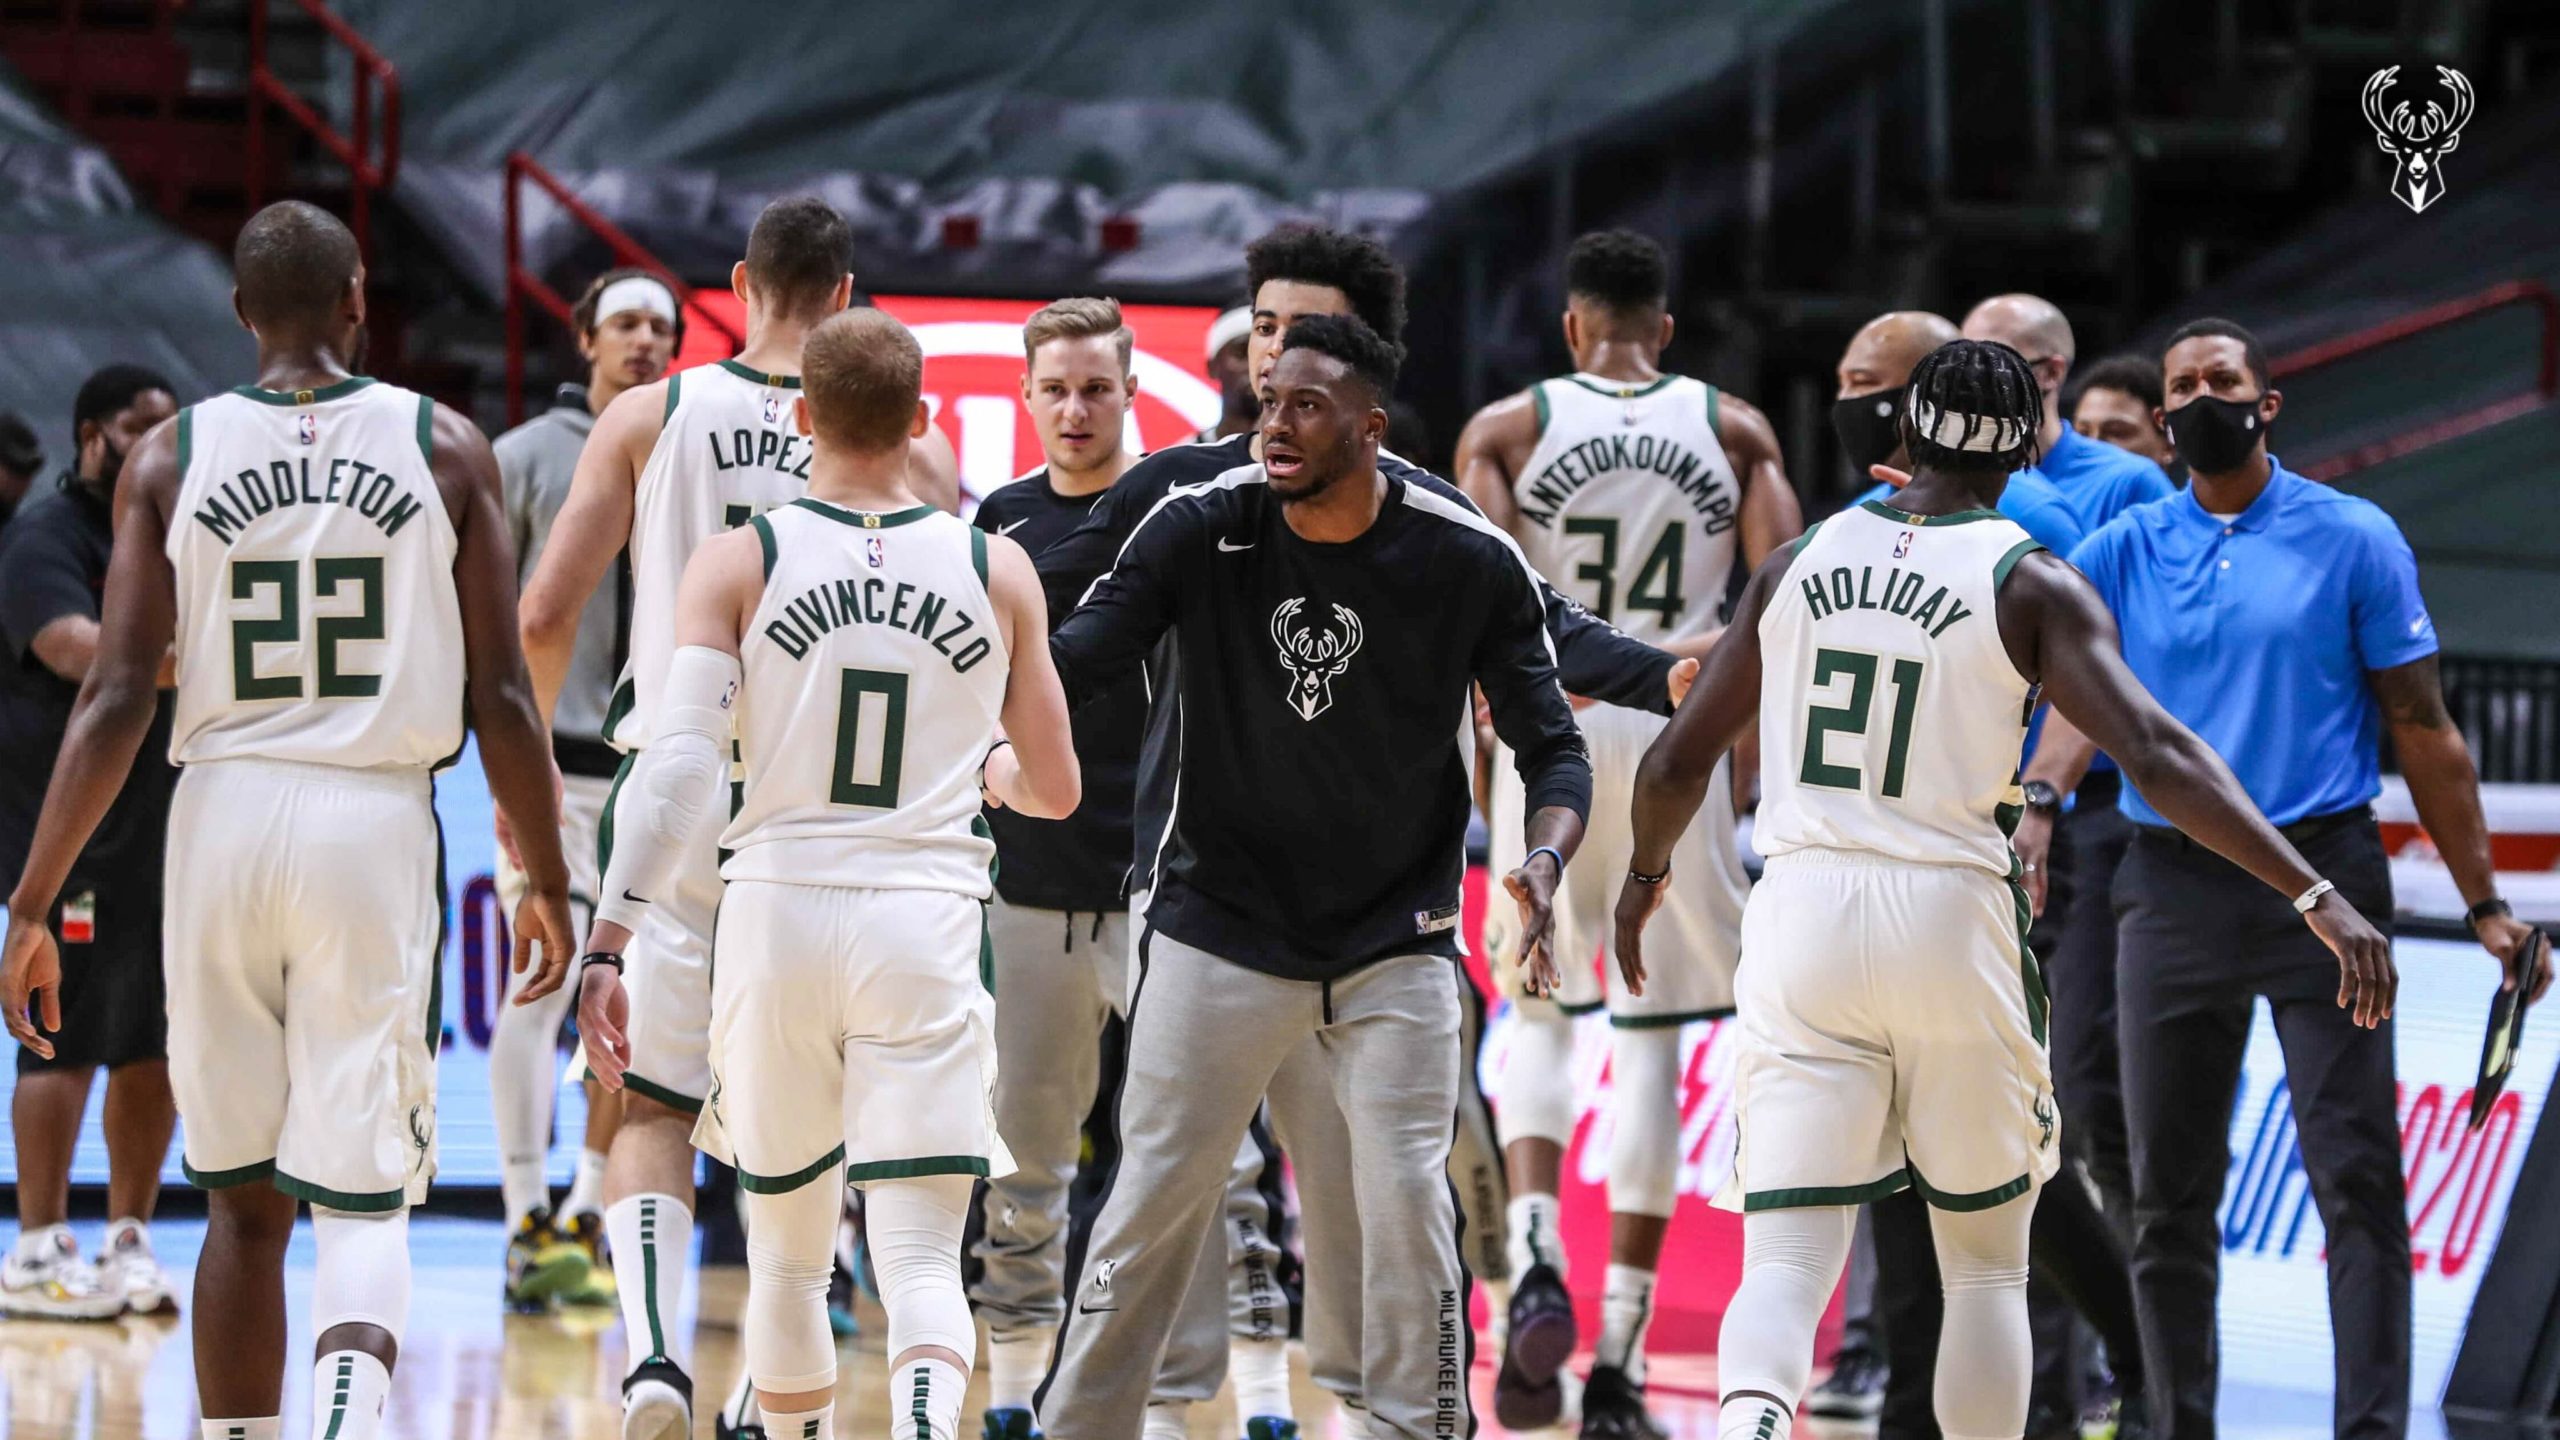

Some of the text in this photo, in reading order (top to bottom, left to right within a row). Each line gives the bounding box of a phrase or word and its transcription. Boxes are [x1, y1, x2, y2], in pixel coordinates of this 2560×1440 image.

[194, 458, 422, 546] MIDDLETON
[1521, 436, 1735, 535] ANTETOKOUNMPO
[1566, 517, 1686, 629] 34
[1801, 566, 1972, 639] HOLIDAY
[231, 557, 384, 700] 22
[765, 578, 990, 673] DIVINCENZO
[830, 668, 908, 809] 0
[1800, 648, 1923, 798] 21
[1438, 1290, 1457, 1391] MILWAUKEE
